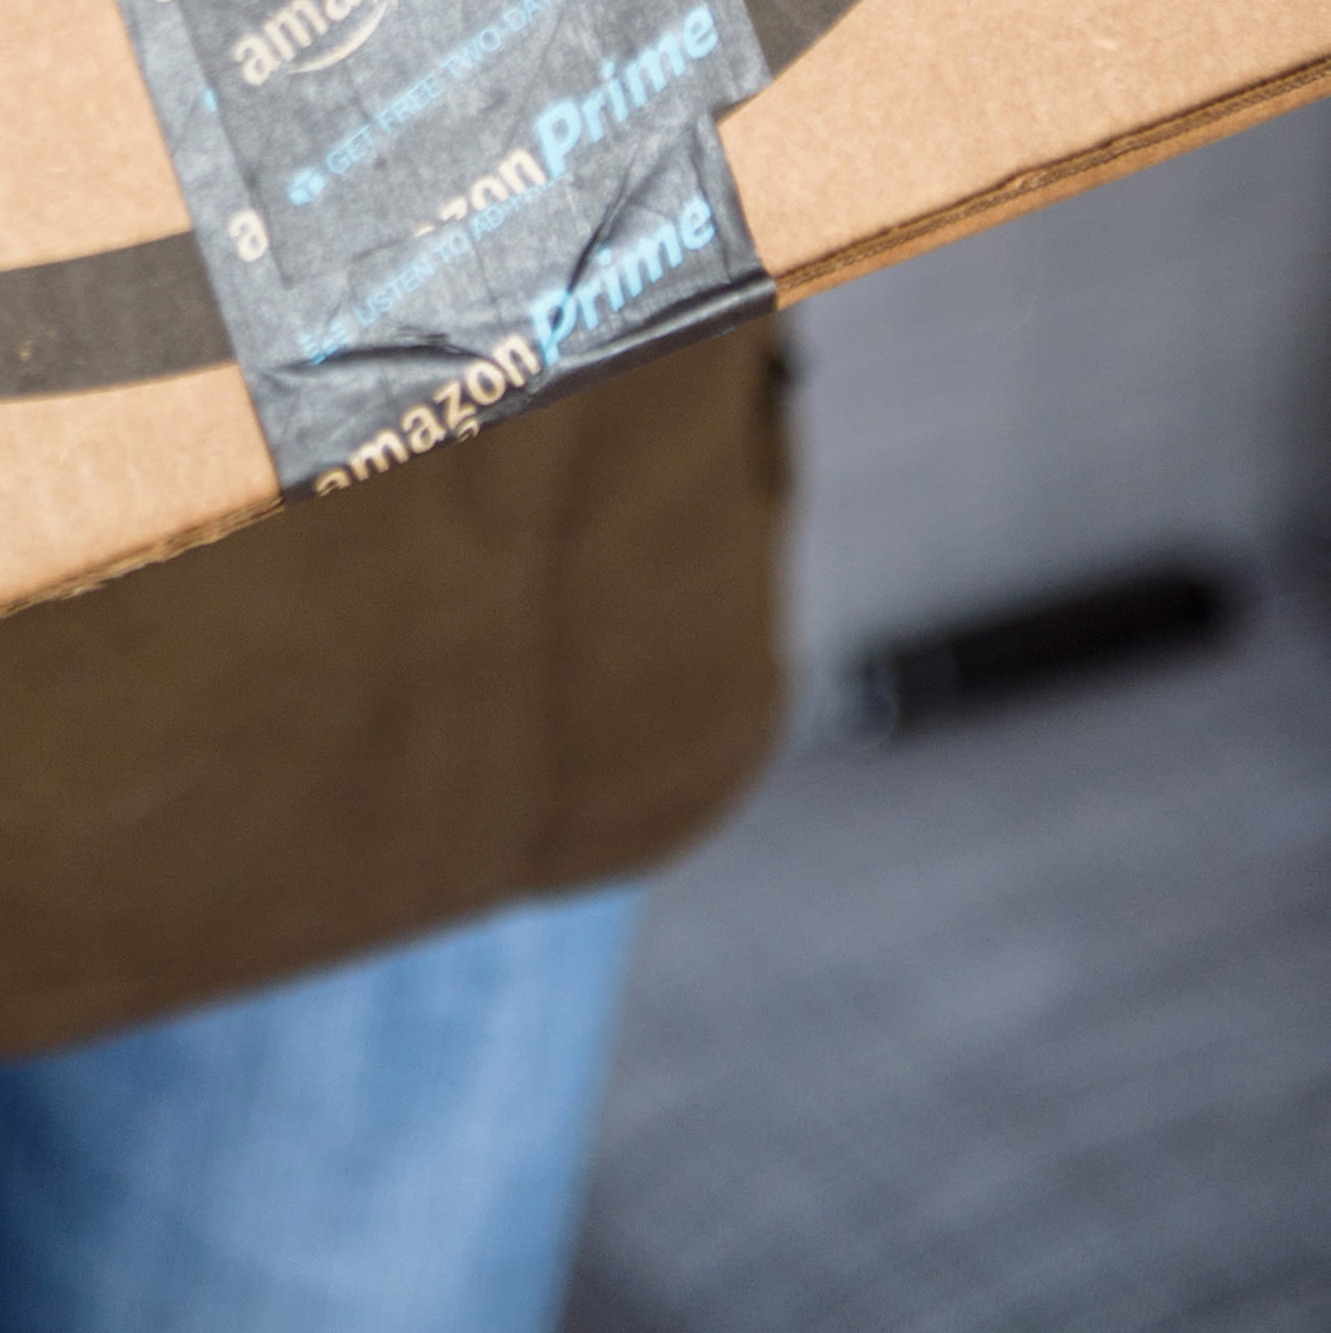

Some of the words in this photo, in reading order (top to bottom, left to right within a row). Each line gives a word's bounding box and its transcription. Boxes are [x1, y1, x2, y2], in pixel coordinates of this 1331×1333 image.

[325, 122, 377, 176] GET
[376, 72, 444, 133] FREE
[353, 259, 437, 328] LISTEN
[432, 231, 470, 274] TO
